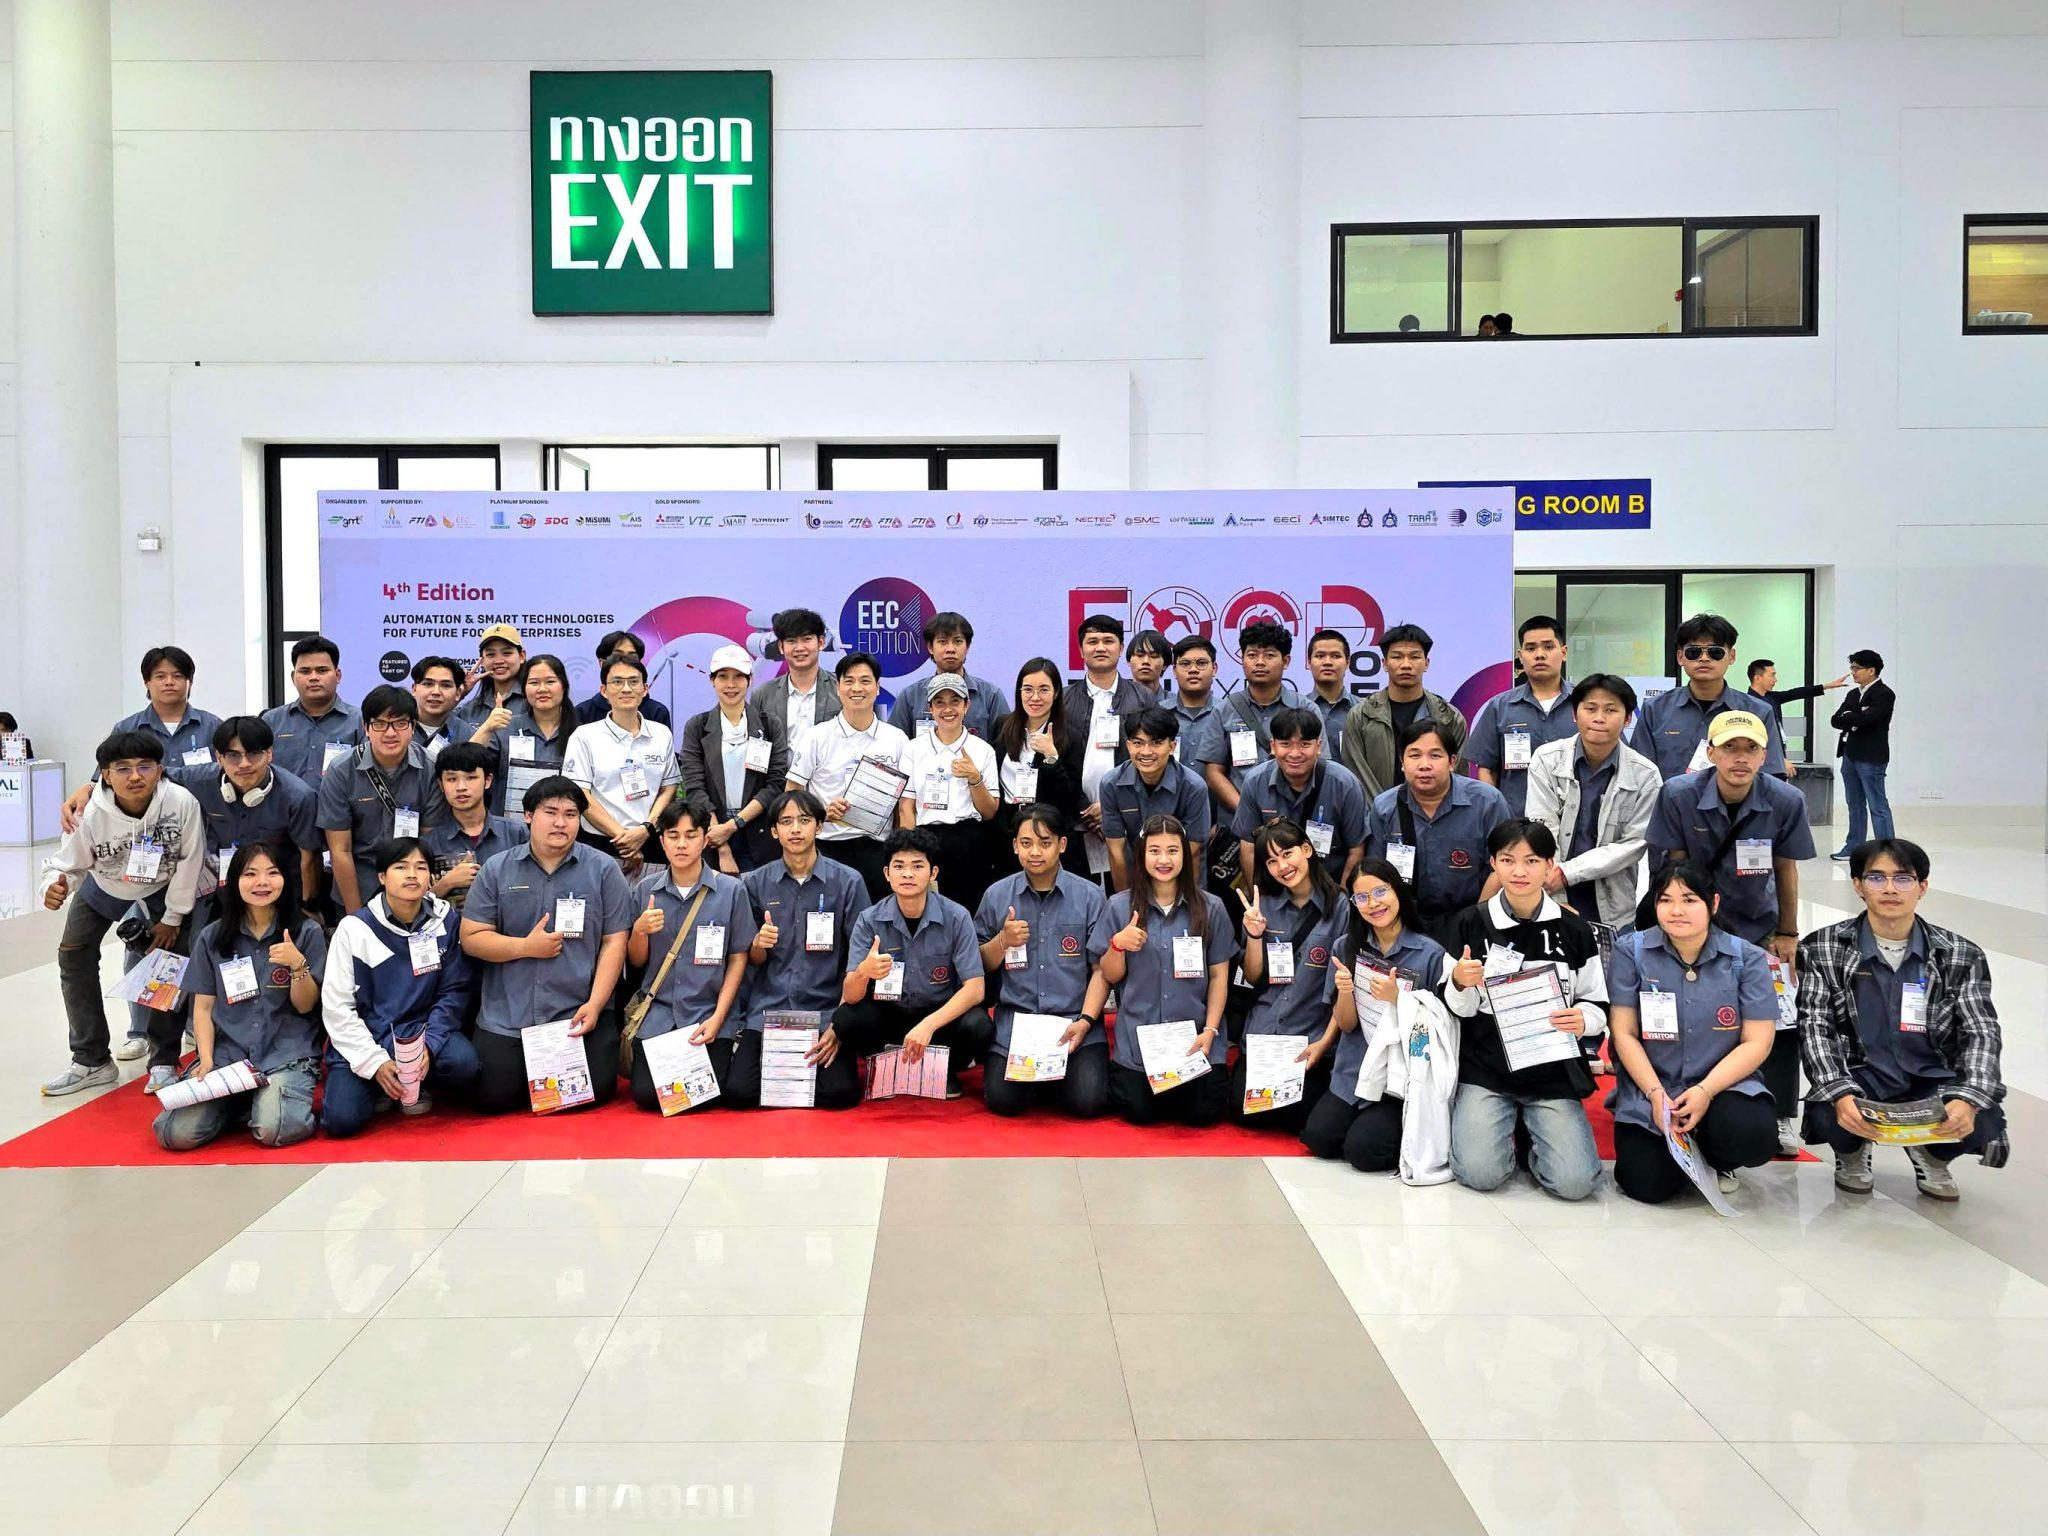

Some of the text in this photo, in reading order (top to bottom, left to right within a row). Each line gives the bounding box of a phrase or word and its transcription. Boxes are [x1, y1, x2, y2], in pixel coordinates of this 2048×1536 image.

[550, 116, 753, 163] ทางออก
[550, 173, 753, 270] EXIT
[1544, 495, 1620, 515] ROOM
[1628, 494, 1645, 514] B
[544, 517, 569, 525] SDG
[1133, 516, 1160, 524] SMC
[382, 582, 495, 601] 4th Edition
[383, 614, 615, 624] AUTOMATION & SMART TECHNOLOGIES
[857, 600, 900, 629] EEC
[383, 628, 582, 638] FOR FUTURE FOO ERPRISES
[857, 630, 921, 655] EDITION
[128, 876, 152, 884] VISITOR
[232, 990, 257, 1003] VISITOR
